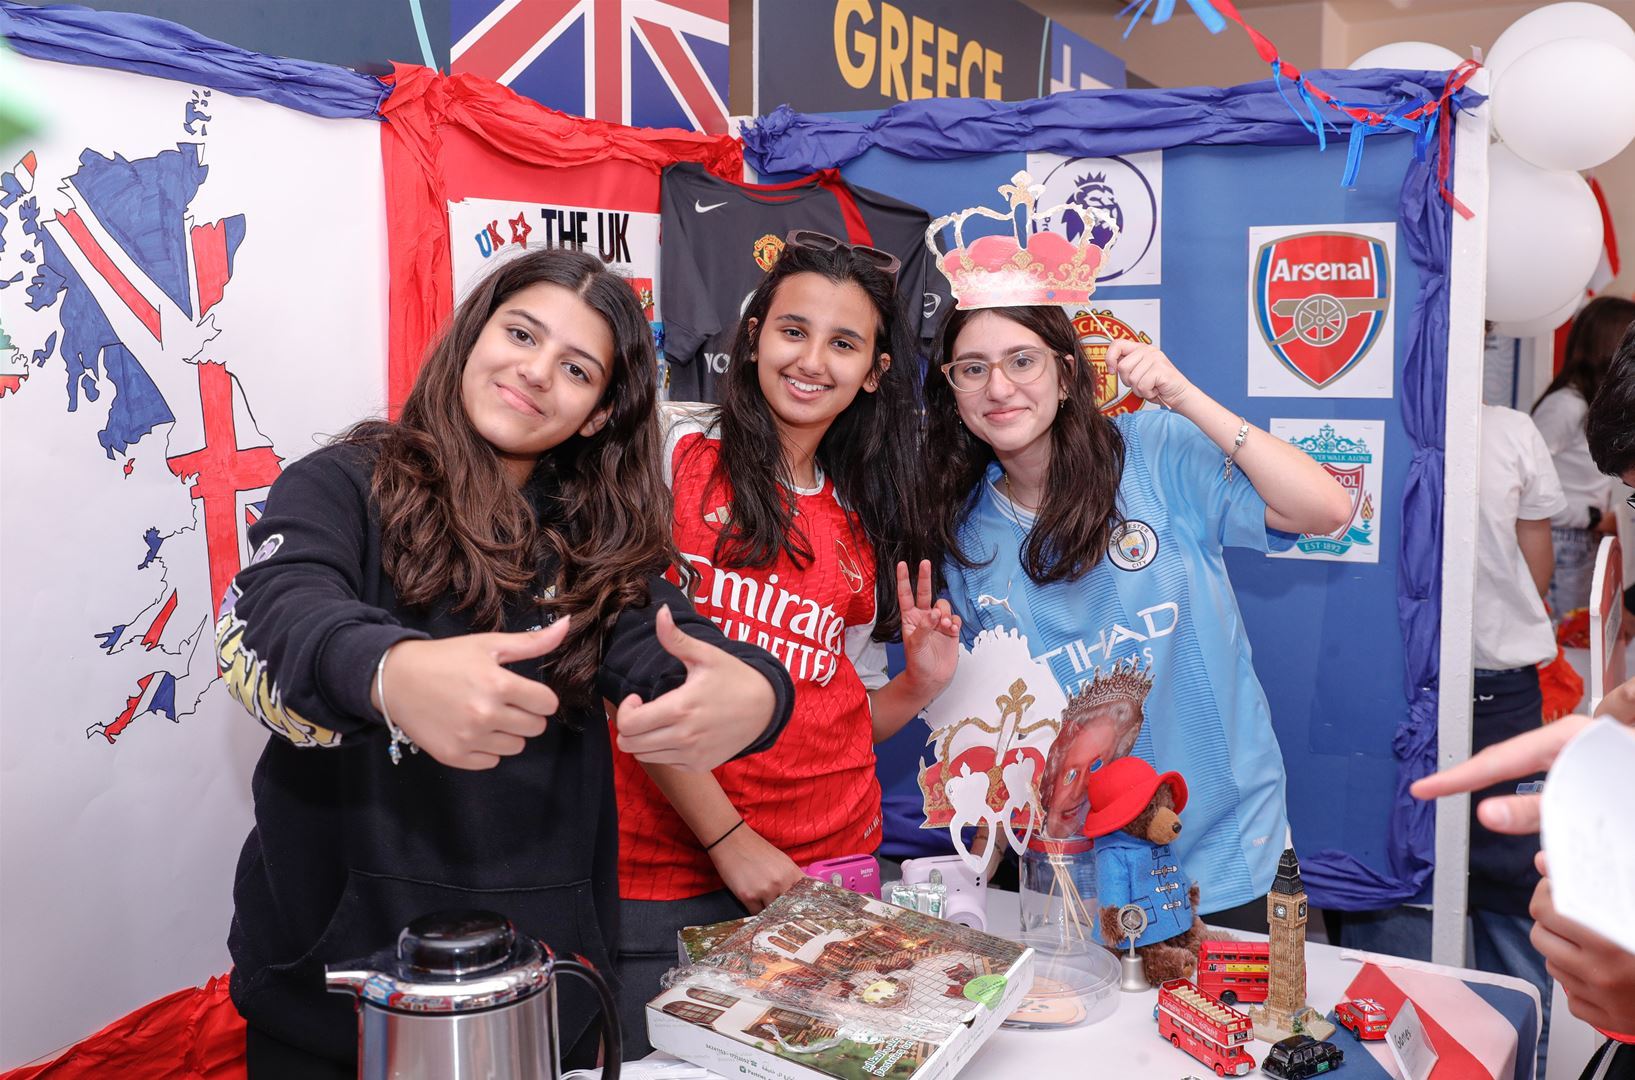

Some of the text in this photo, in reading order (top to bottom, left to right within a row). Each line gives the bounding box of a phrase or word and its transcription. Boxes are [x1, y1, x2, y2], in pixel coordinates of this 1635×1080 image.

[834, 0, 1002, 101] GREECE
[474, 219, 505, 258] UK
[541, 208, 631, 263] THE UK
[1271, 256, 1371, 282] Arsenal
[1110, 523, 1150, 546] MANCESTER
[1131, 560, 1148, 568] CITY
